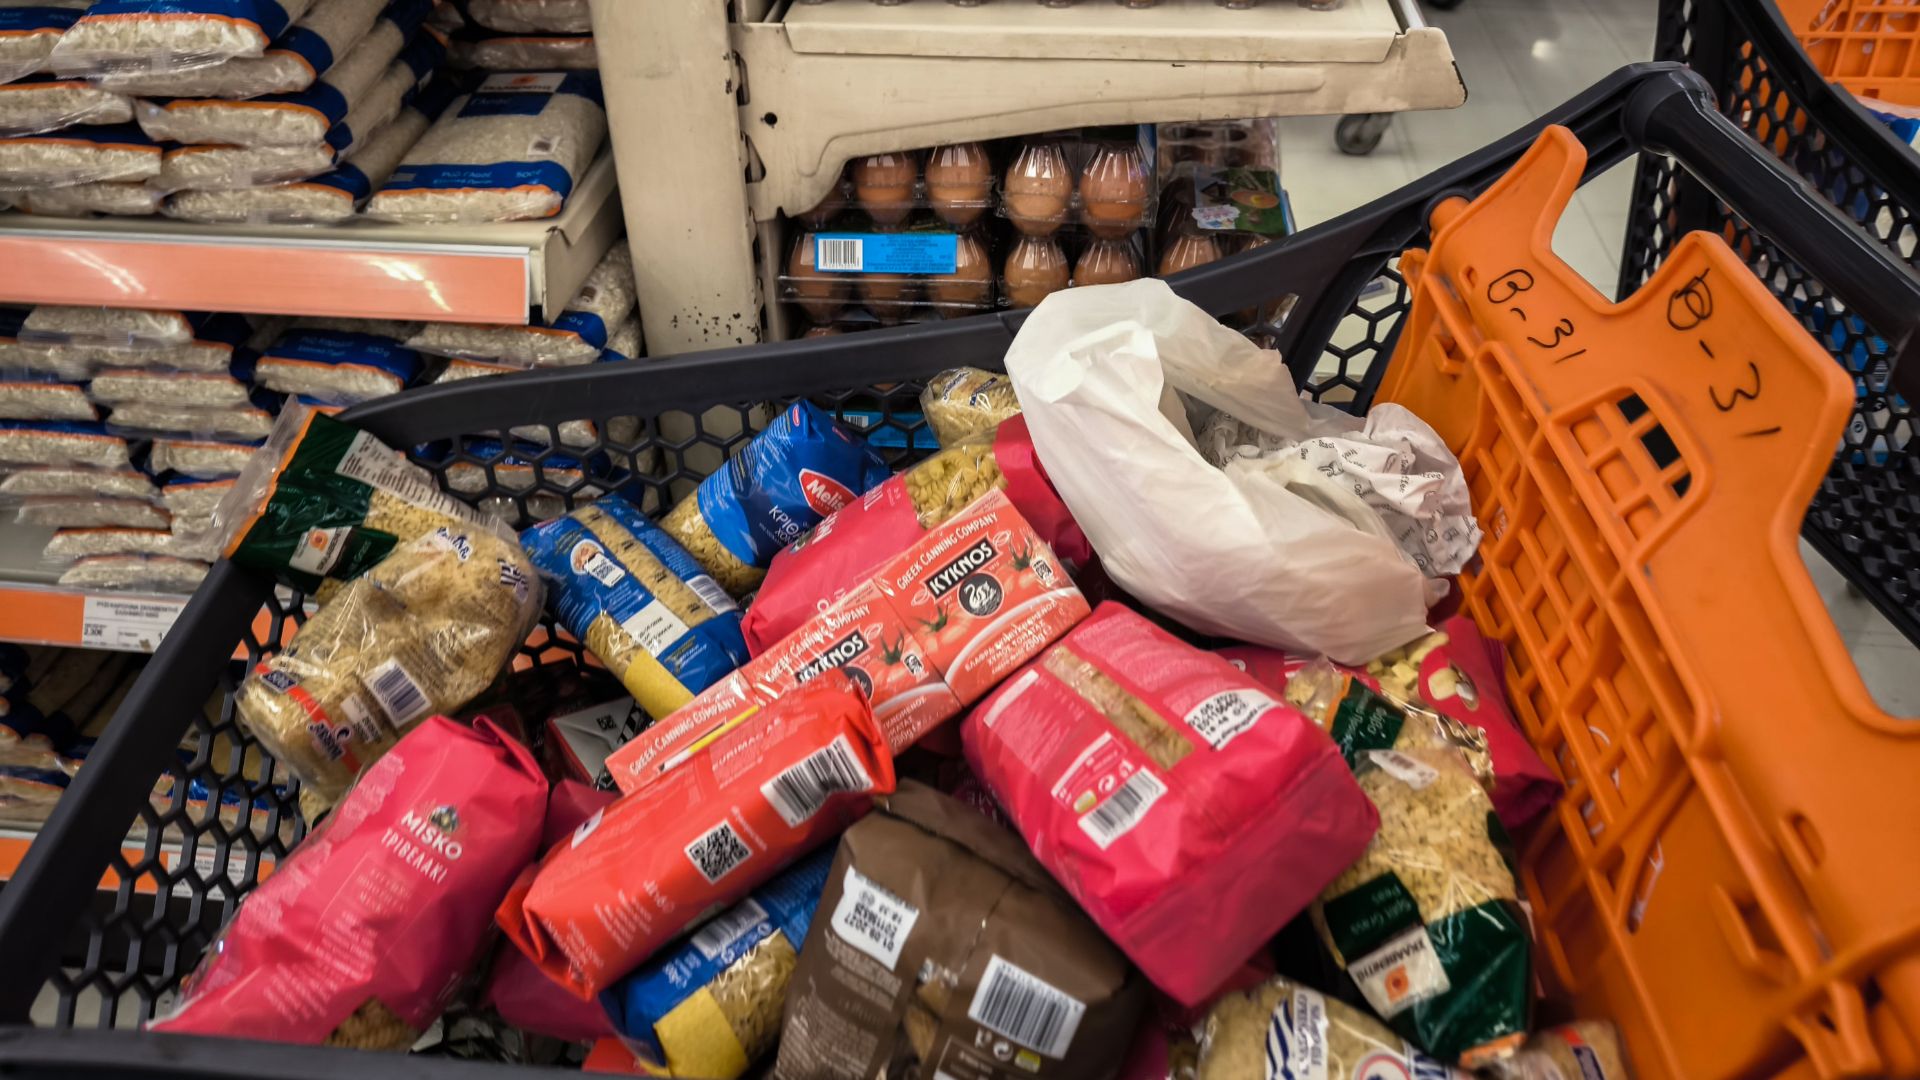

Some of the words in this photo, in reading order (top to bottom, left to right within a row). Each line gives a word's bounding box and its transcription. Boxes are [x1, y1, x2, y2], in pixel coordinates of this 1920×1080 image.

[806, 478, 846, 514] Melis
[897, 560, 923, 590] GREEK
[920, 533, 958, 567] CANNING
[955, 512, 999, 541] COMPANY
[929, 541, 994, 596] KYKNOS
[654, 716, 695, 748] CANNING
[692, 695, 738, 724] COMPANY
[380, 826, 449, 885] ΤΡΙΒΕΛΑΚΙ
[400, 808, 463, 860] MISKO
